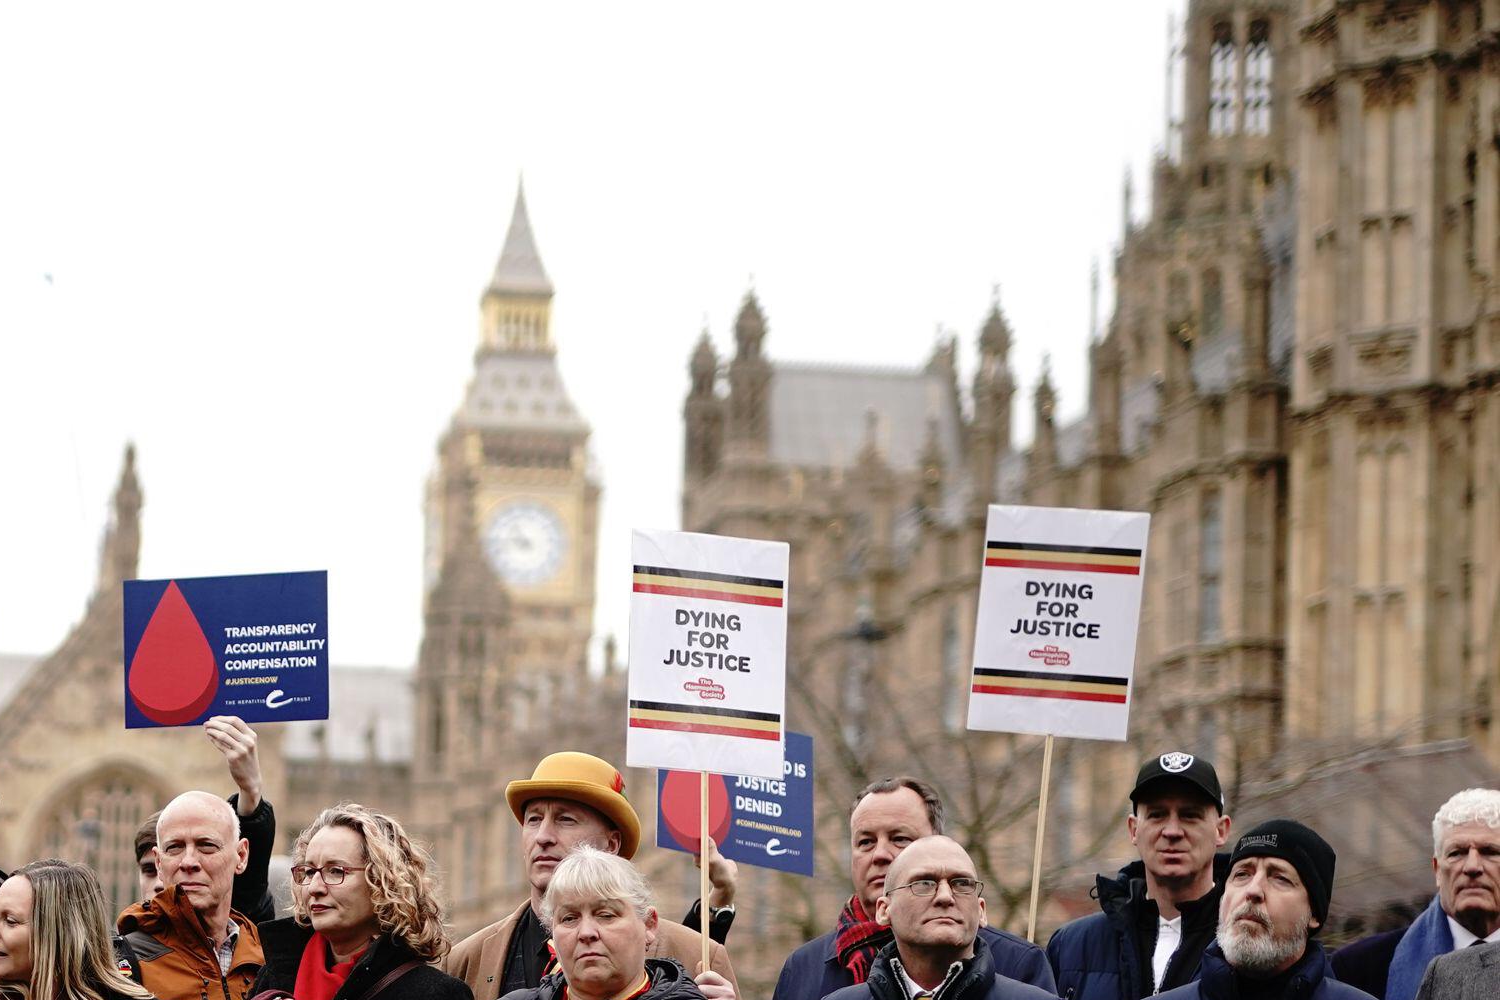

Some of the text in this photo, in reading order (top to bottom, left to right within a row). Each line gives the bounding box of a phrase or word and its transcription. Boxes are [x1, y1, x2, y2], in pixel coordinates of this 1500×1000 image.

[1025, 580, 1094, 600] DYING
[1036, 601, 1079, 618] FOR
[224, 622, 317, 638] TRANSPARENCY
[674, 608, 742, 632] DYING
[1010, 619, 1101, 639] JUSTICE
[224, 639, 326, 655] ACCOUNTABILITY
[687, 630, 730, 650] FOR
[224, 656, 317, 671] COMPENSATION
[663, 648, 751, 673] JUSTICE
[225, 676, 278, 686] #JUSTICENOW
[794, 762, 807, 778] IS
[735, 776, 787, 797] JUSTICE
[735, 795, 782, 817] DENIED
[736, 818, 802, 838] #CONTAMINATEDBLOOD
